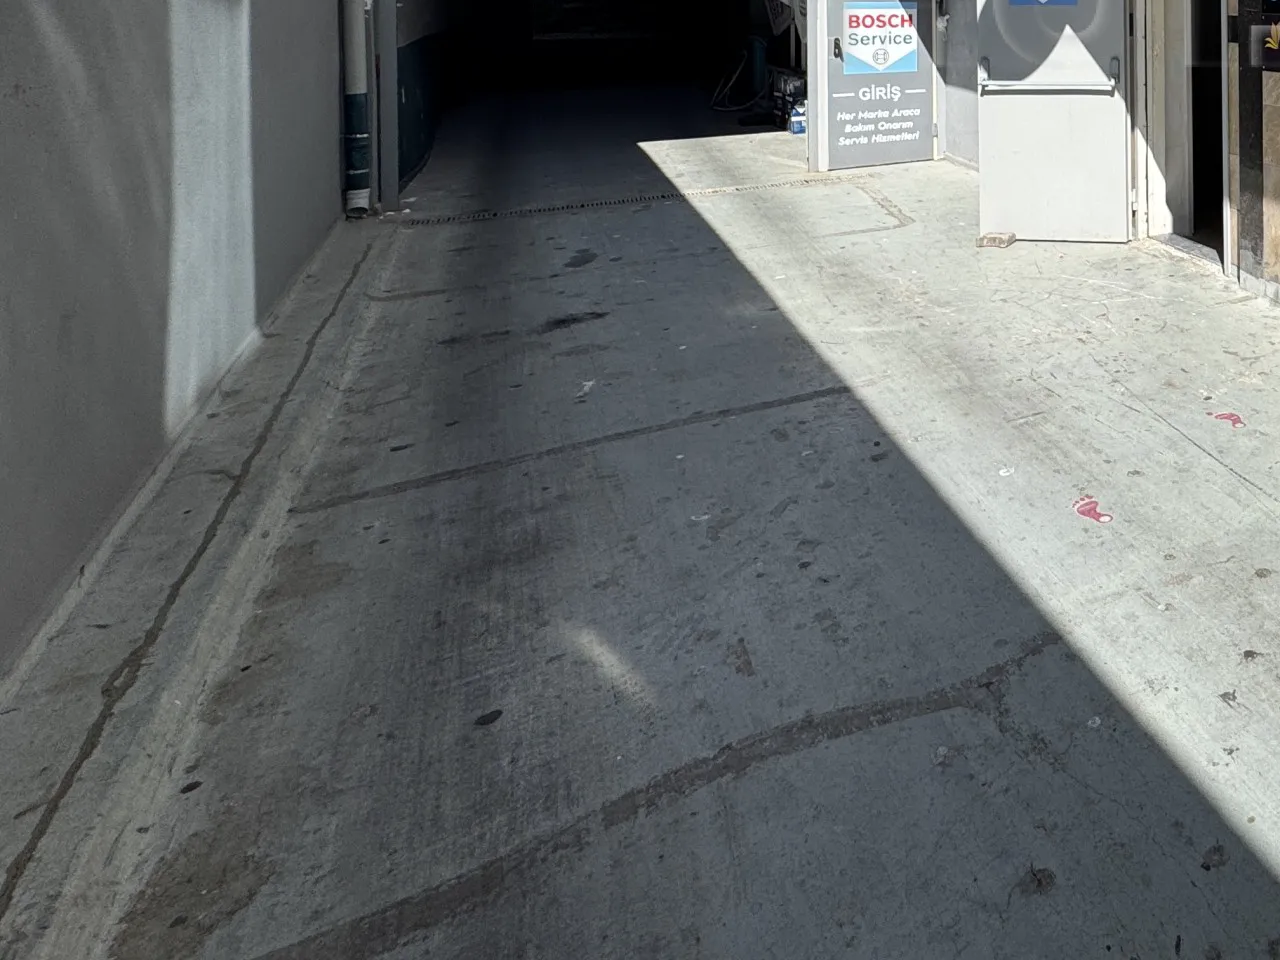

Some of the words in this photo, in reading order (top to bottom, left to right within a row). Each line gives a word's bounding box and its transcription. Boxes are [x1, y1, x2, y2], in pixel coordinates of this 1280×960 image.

[848, 13, 913, 29] BOSCH
[848, 32, 913, 45] Service
[858, 83, 902, 102] GİRİŞ
[837, 111, 857, 121] Her
[858, 109, 889, 120] Marka
[891, 107, 921, 117] Araca
[844, 123, 875, 133] Bakım
[877, 121, 914, 131] Onarım
[838, 135, 868, 146] Servis
[871, 130, 920, 143] Hizmetleri
